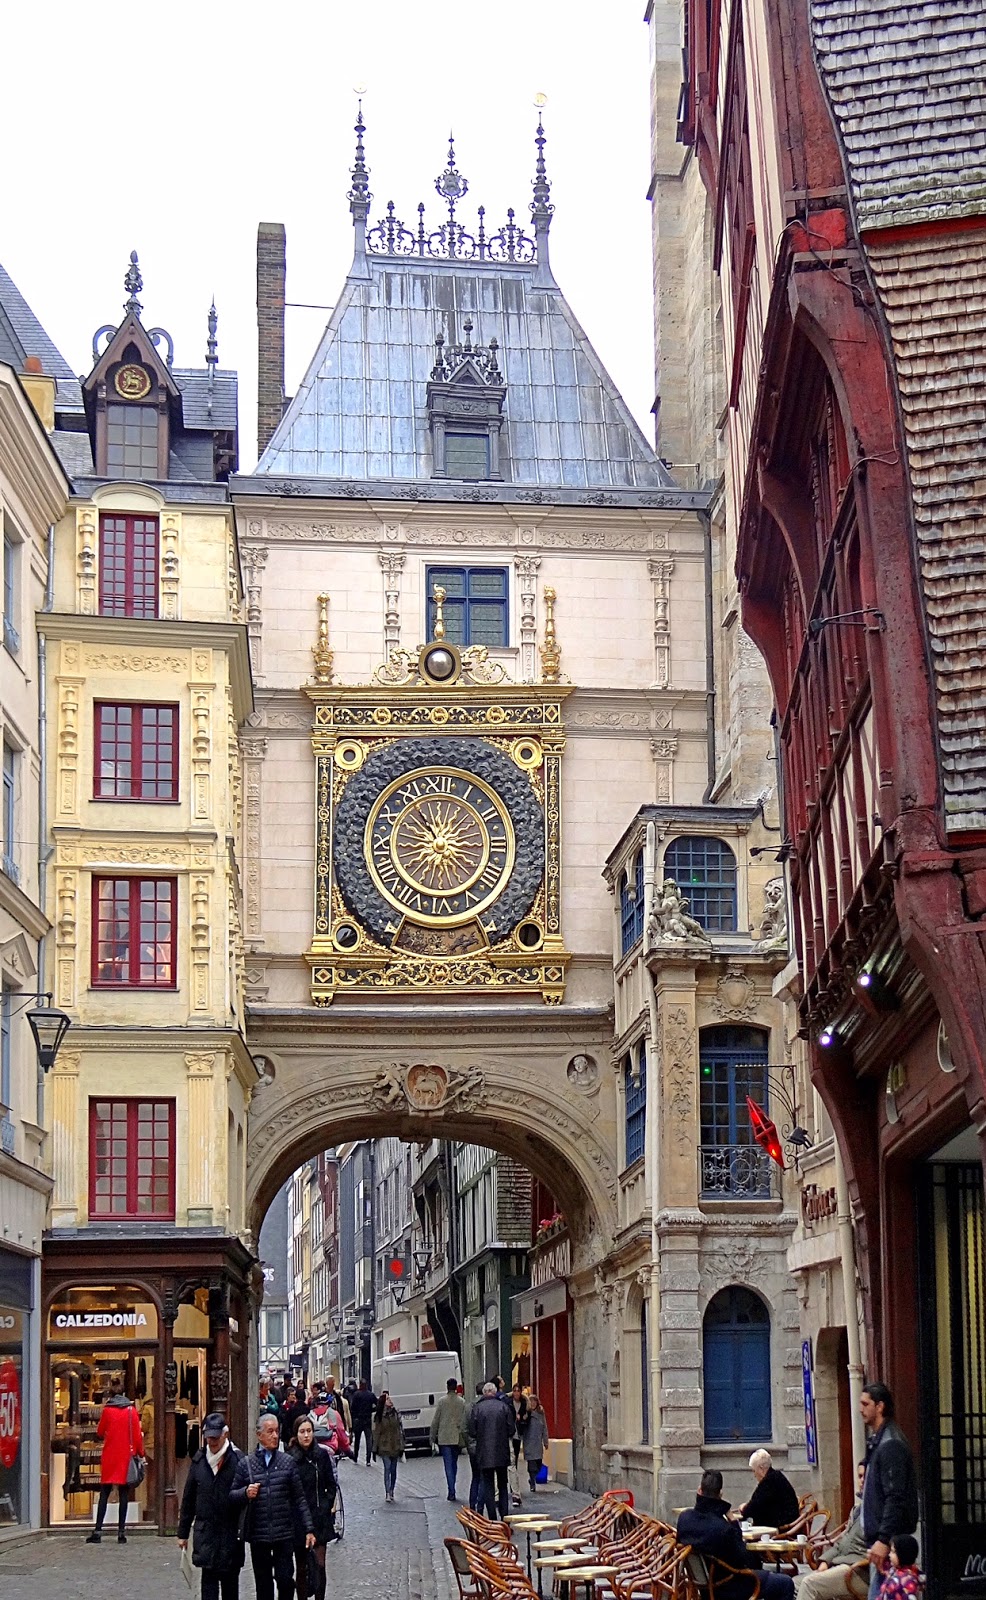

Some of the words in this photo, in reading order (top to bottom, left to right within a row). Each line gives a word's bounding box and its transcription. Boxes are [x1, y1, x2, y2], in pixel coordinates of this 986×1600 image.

[397, 781, 422, 805] XI
[424, 776, 452, 794] XII
[463, 784, 474, 801] I
[379, 804, 400, 826] X
[480, 806, 499, 823] II
[374, 834, 390, 855] IX
[490, 836, 506, 853] III
[480, 861, 503, 889] IIII
[397, 887, 423, 911] VII
[431, 897, 453, 914] VI
[464, 890, 481, 909] V
[55, 1313, 148, 1328] CALZEDONIA
